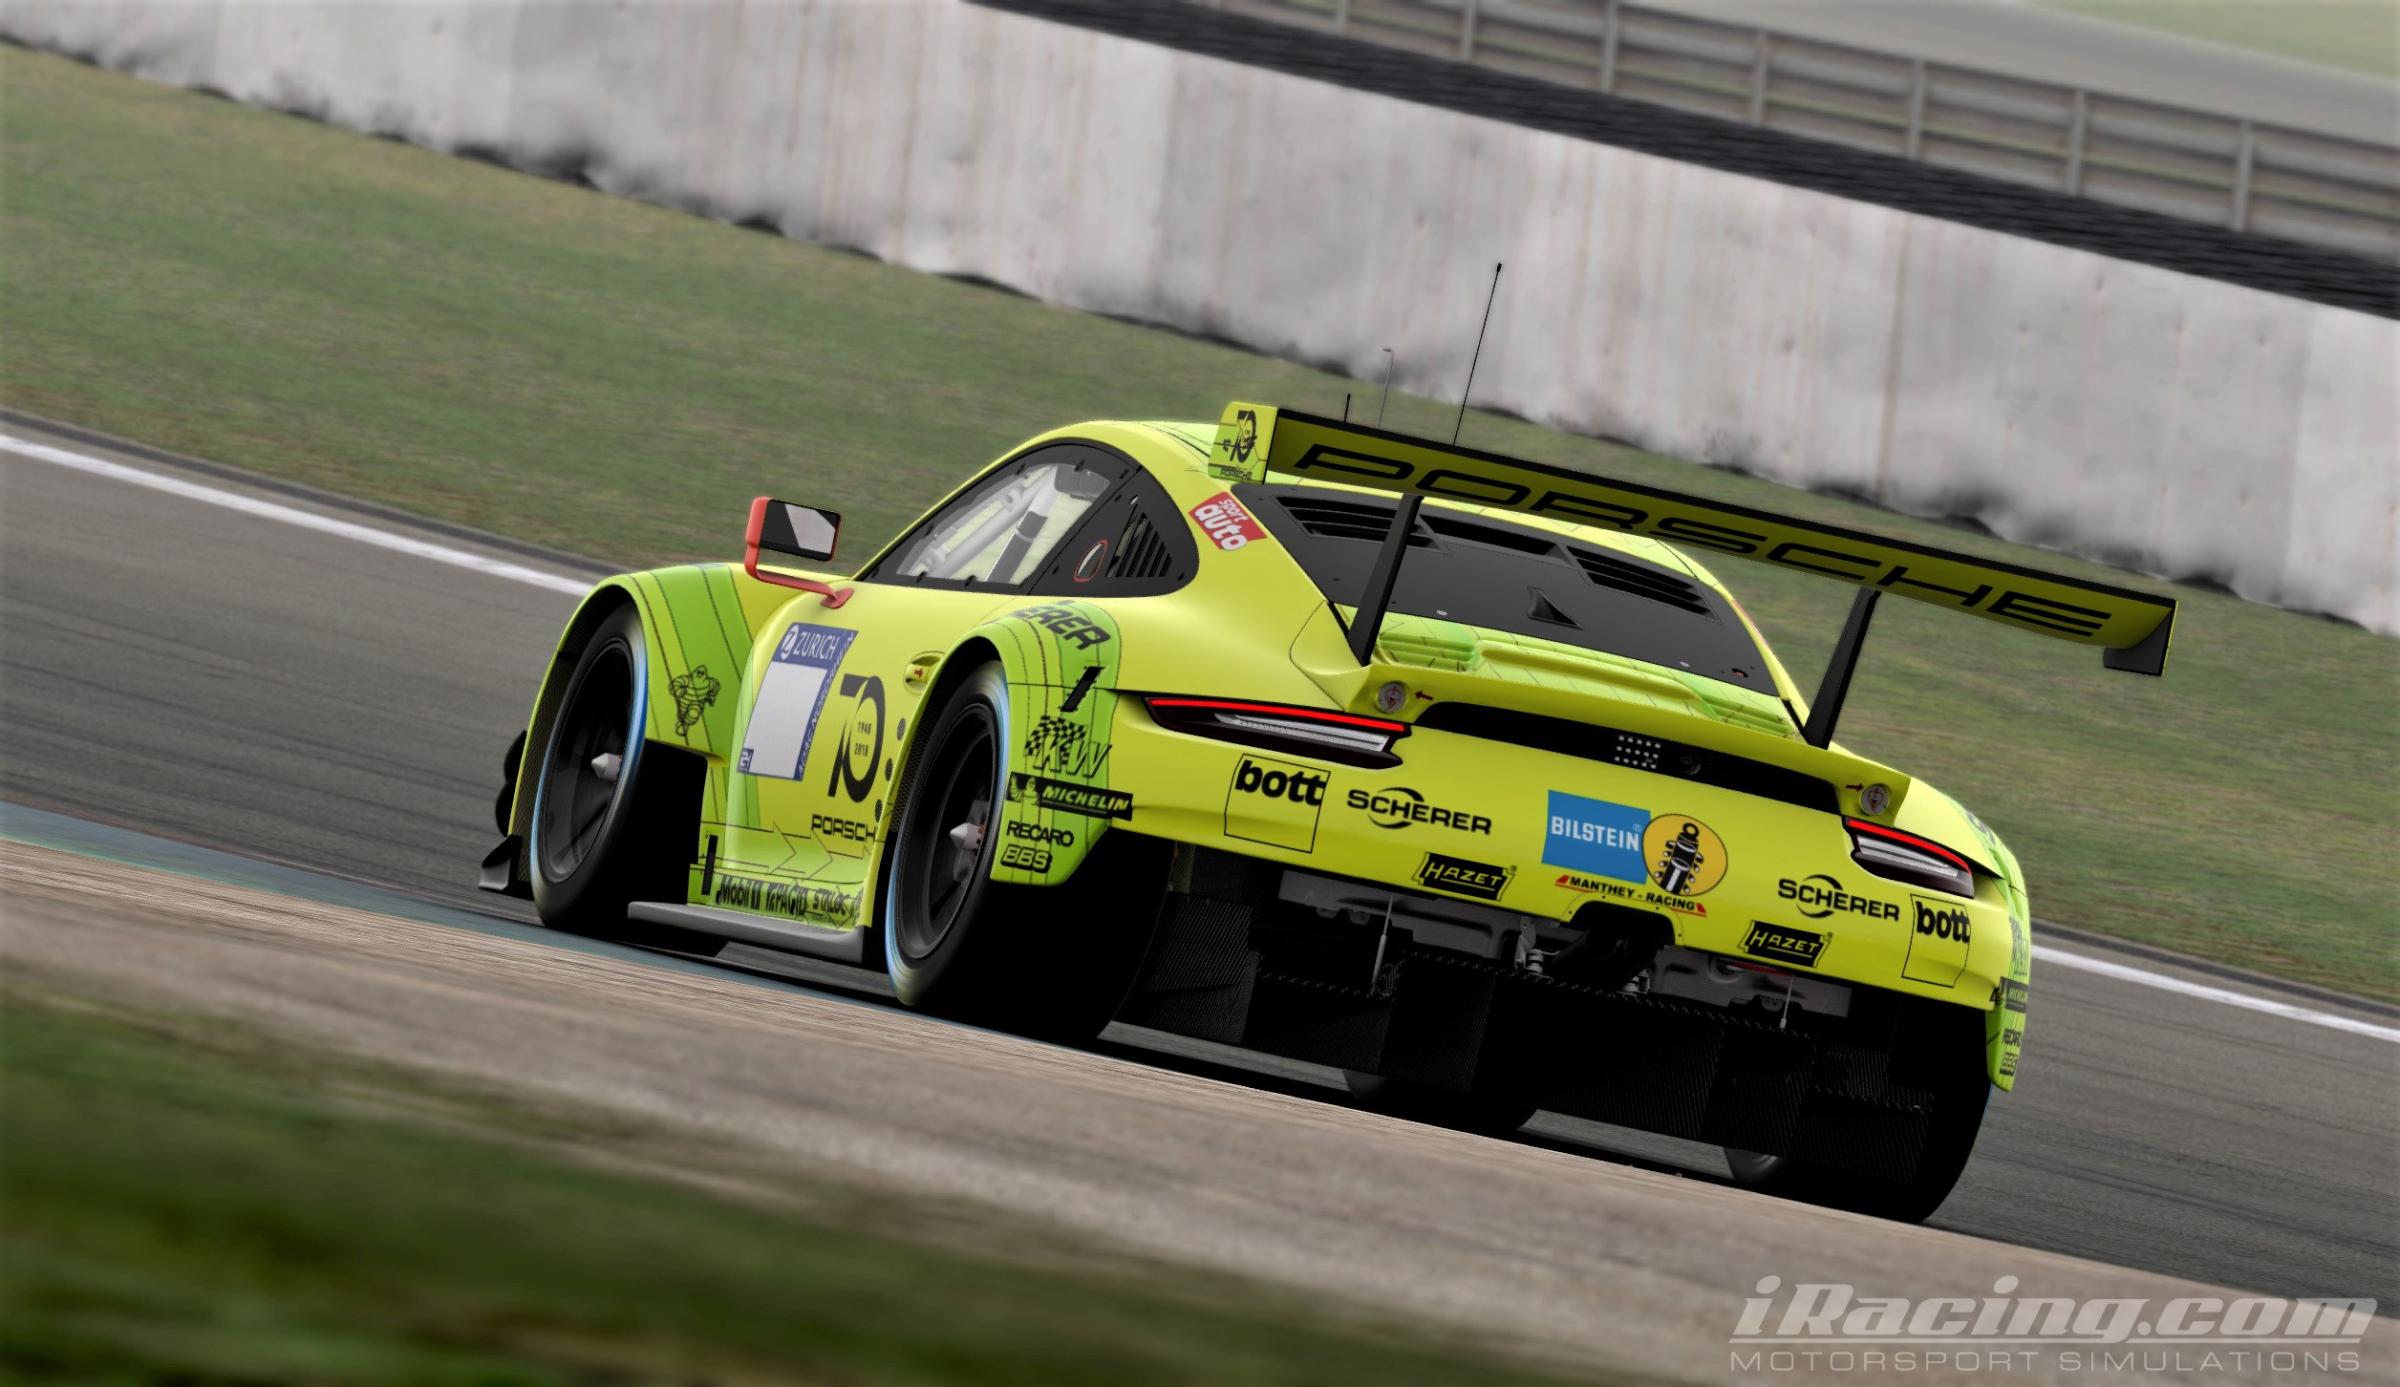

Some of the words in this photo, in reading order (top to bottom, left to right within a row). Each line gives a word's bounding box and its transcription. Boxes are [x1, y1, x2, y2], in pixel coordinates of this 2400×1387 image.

[1194, 503, 1248, 551] auto
[1218, 498, 1249, 522] sport
[1294, 443, 2112, 637] PORSCHE
[1008, 604, 1111, 650] ERER
[793, 631, 840, 661] ZURICH
[1033, 735, 1113, 778] KW
[1042, 785, 1129, 811] MICHELIN
[1235, 760, 1327, 806] bott
[811, 813, 877, 843] PORSCH
[1346, 787, 1493, 835] SCHERER
[1007, 820, 1075, 847] RECARO
[1551, 815, 1640, 851] BILSTEIN
[1001, 844, 1052, 873] BBS
[1425, 861, 1503, 888] HAZET
[1569, 876, 1635, 898] MANTHEY
[1646, 892, 1696, 911] RACING
[1777, 875, 1901, 922] SCHERER
[1915, 901, 1971, 944] bott
[1750, 930, 1820, 954] HAZET
